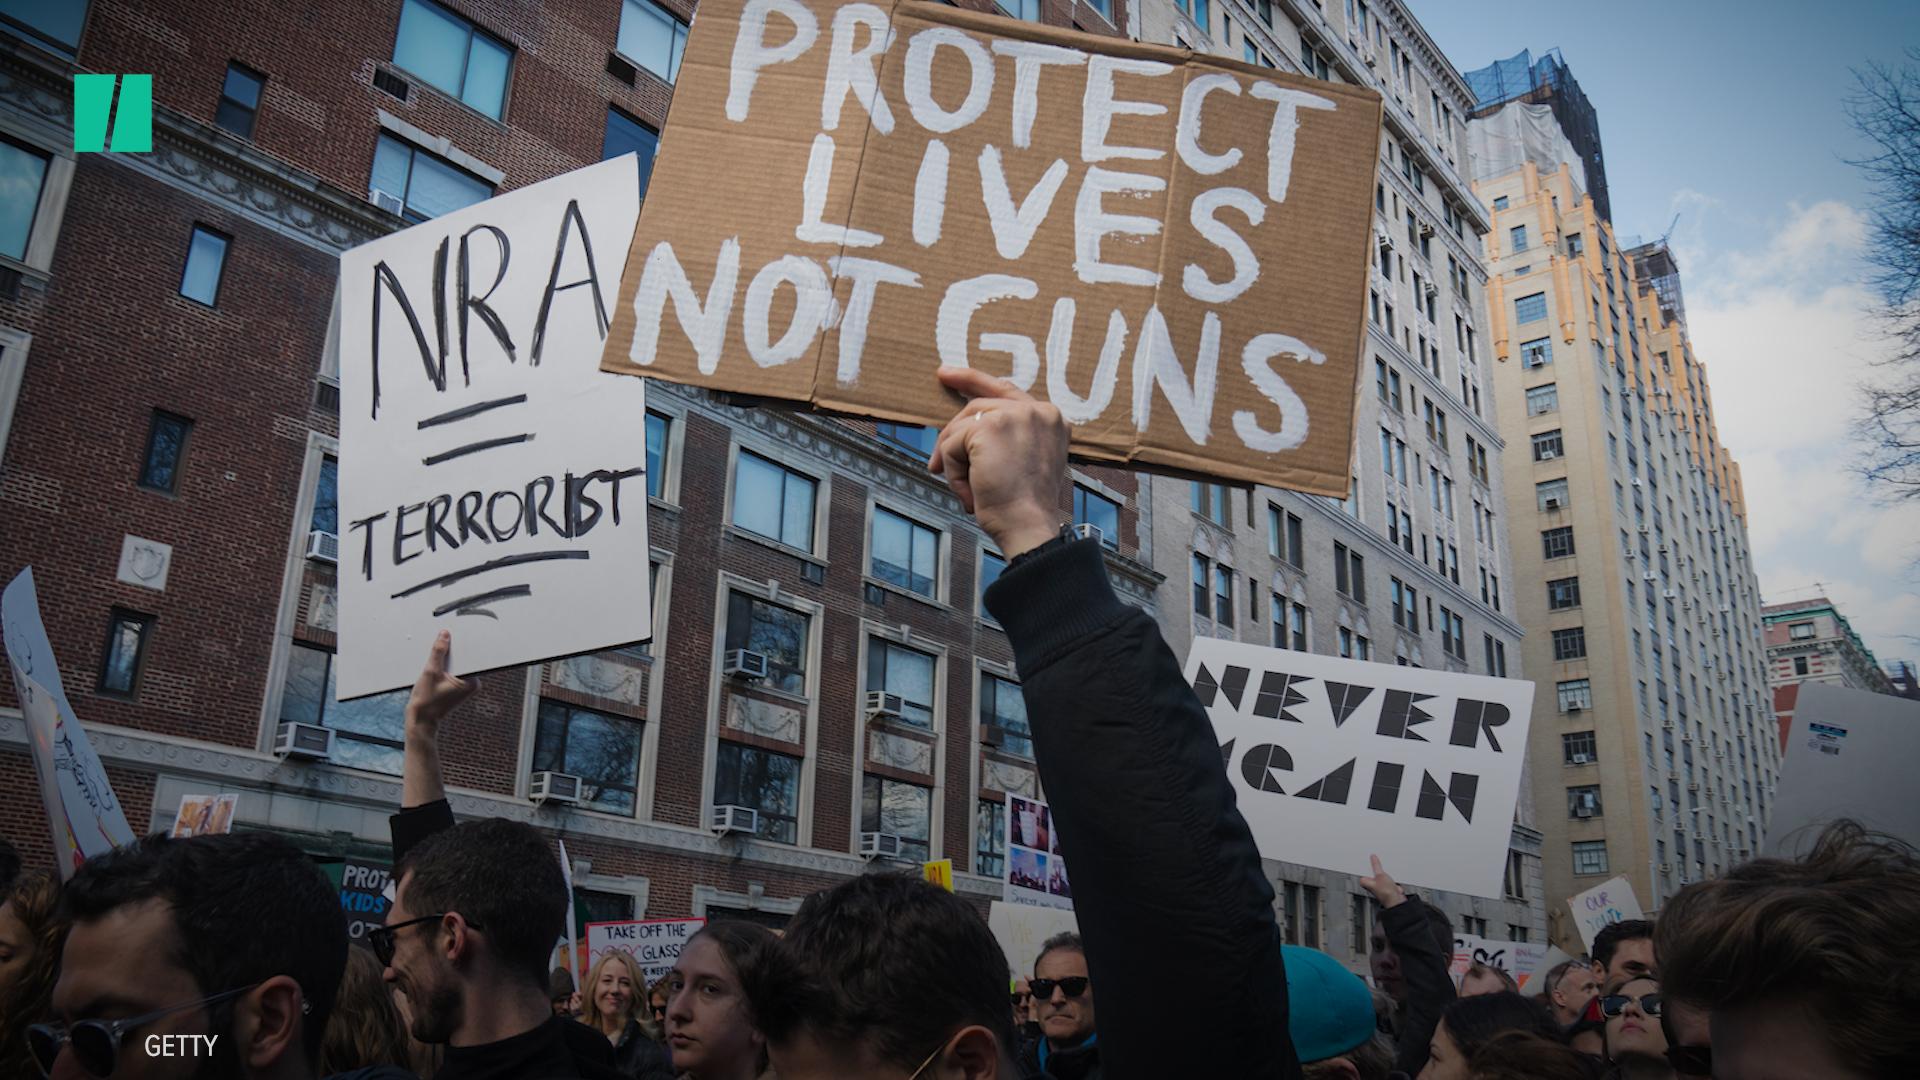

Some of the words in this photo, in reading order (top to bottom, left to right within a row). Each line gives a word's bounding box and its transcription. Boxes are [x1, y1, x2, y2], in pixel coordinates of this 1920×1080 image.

[725, 0, 1337, 203] PROTECT
[795, 132, 1267, 304] LIVES
[370, 198, 612, 421] NRA
[629, 235, 922, 388] NOT
[936, 274, 1327, 453] GUNS
[349, 466, 646, 581] TERRORIST
[1194, 661, 1511, 753] NEVER
[340, 889, 386, 913] KIDS
[342, 864, 391, 889] PROT
[604, 925, 636, 939] TAKE
[640, 925, 663, 939] OFF
[667, 923, 686, 937] THE
[642, 943, 686, 960] GLASS
